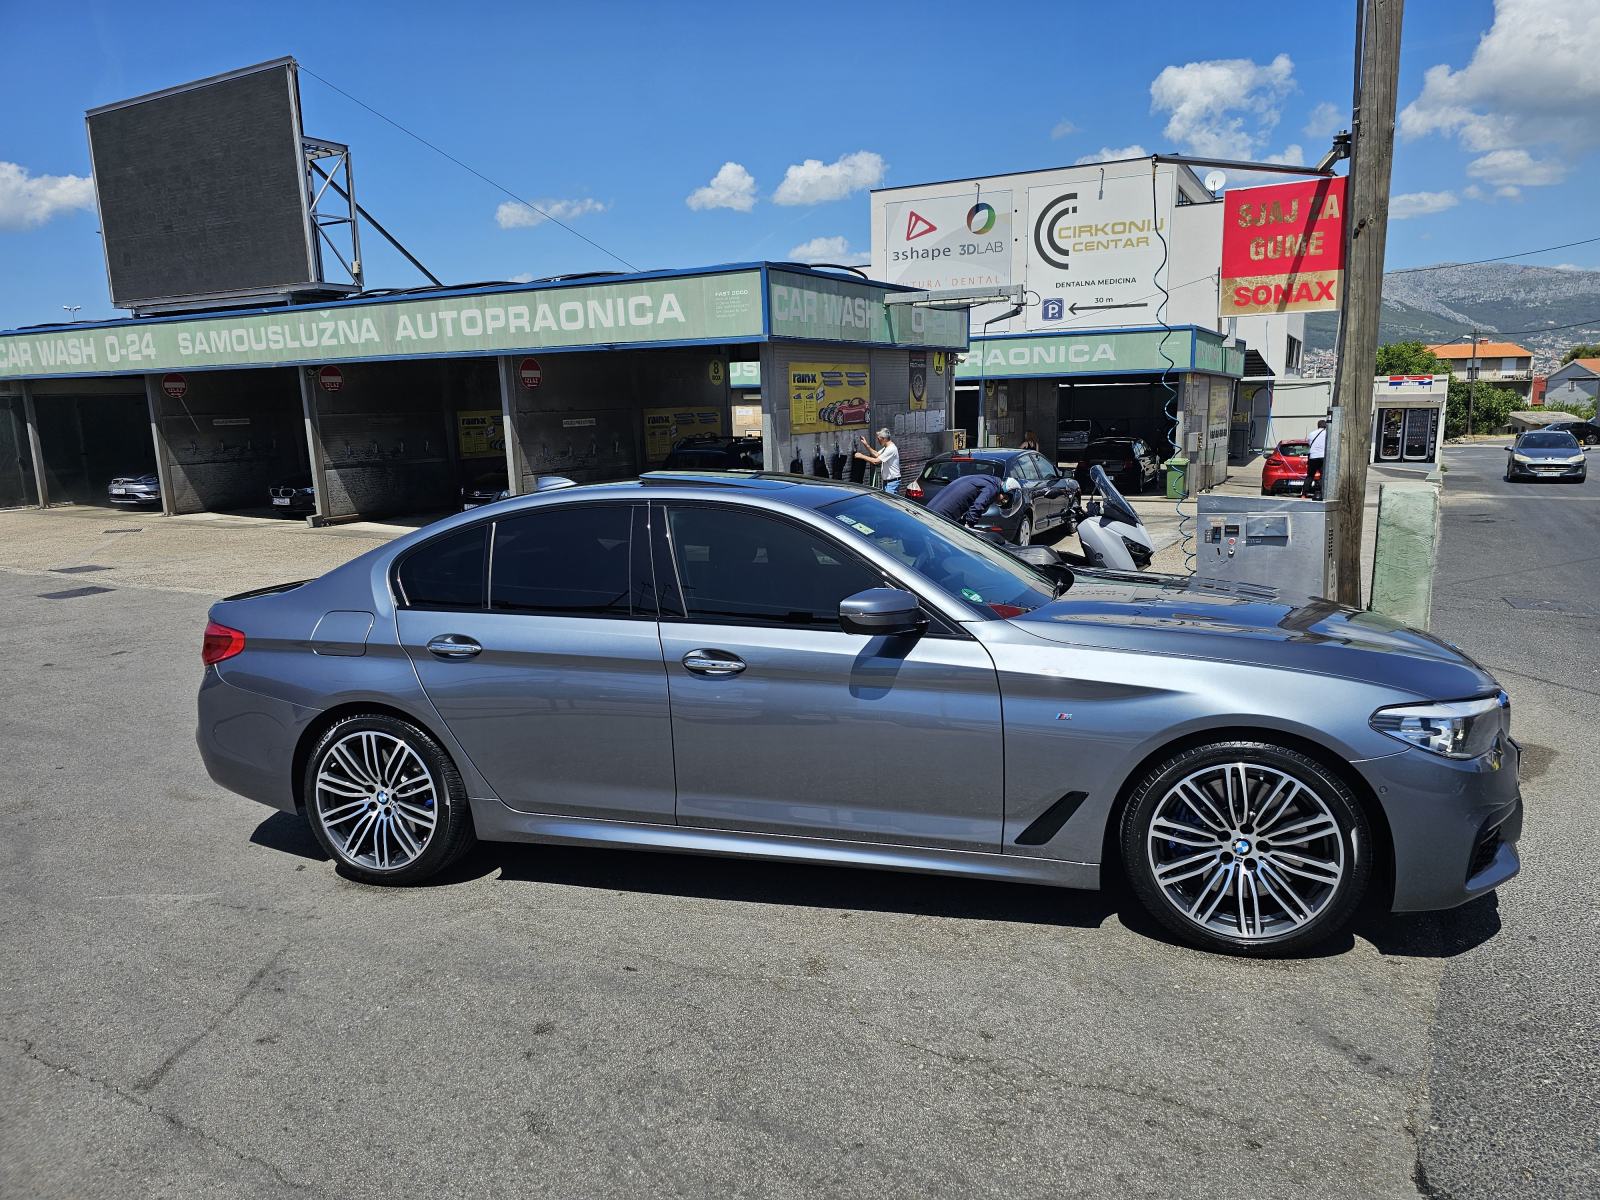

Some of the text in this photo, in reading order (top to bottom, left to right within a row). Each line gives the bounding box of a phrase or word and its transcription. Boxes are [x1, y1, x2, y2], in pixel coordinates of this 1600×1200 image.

[1238, 198, 1299, 228] SJAJ
[1058, 217, 1165, 240] CIRKONIJ
[892, 246, 951, 261] 3shape
[959, 241, 1004, 256] 3DLAB
[1072, 236, 1150, 253] CENTAR
[1249, 231, 1325, 261] GUME
[951, 275, 1001, 287] DENTAL
[1055, 277, 1137, 289] DENTALNA MEDICINA
[774, 286, 817, 323] CAR
[1233, 280, 1336, 308] SONAX
[178, 310, 381, 355] SAMOUSLUŽNA
[395, 293, 686, 341] AUTOPRAONICA
[36, 337, 97, 366] WASH
[105, 332, 156, 363] 0-24
[713, 362, 719, 374] 8
